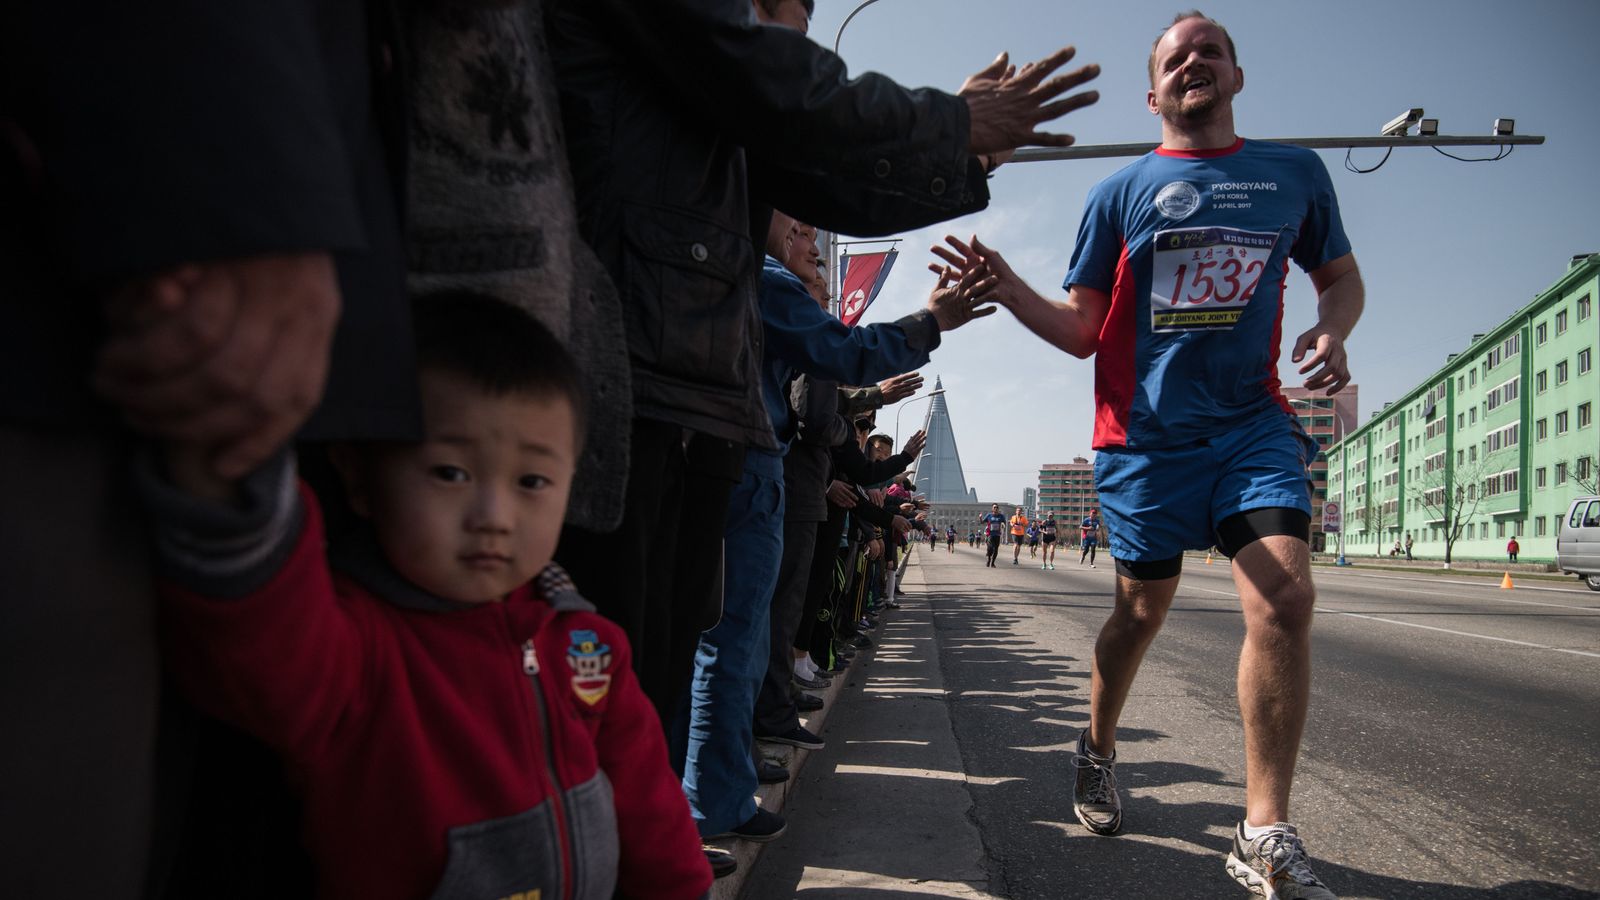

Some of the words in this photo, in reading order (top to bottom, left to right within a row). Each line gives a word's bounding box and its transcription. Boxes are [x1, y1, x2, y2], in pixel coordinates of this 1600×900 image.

[1211, 182, 1278, 191] PYONGYANG
[1170, 258, 1265, 305] 1532
[1207, 313, 1228, 321] JOINT
